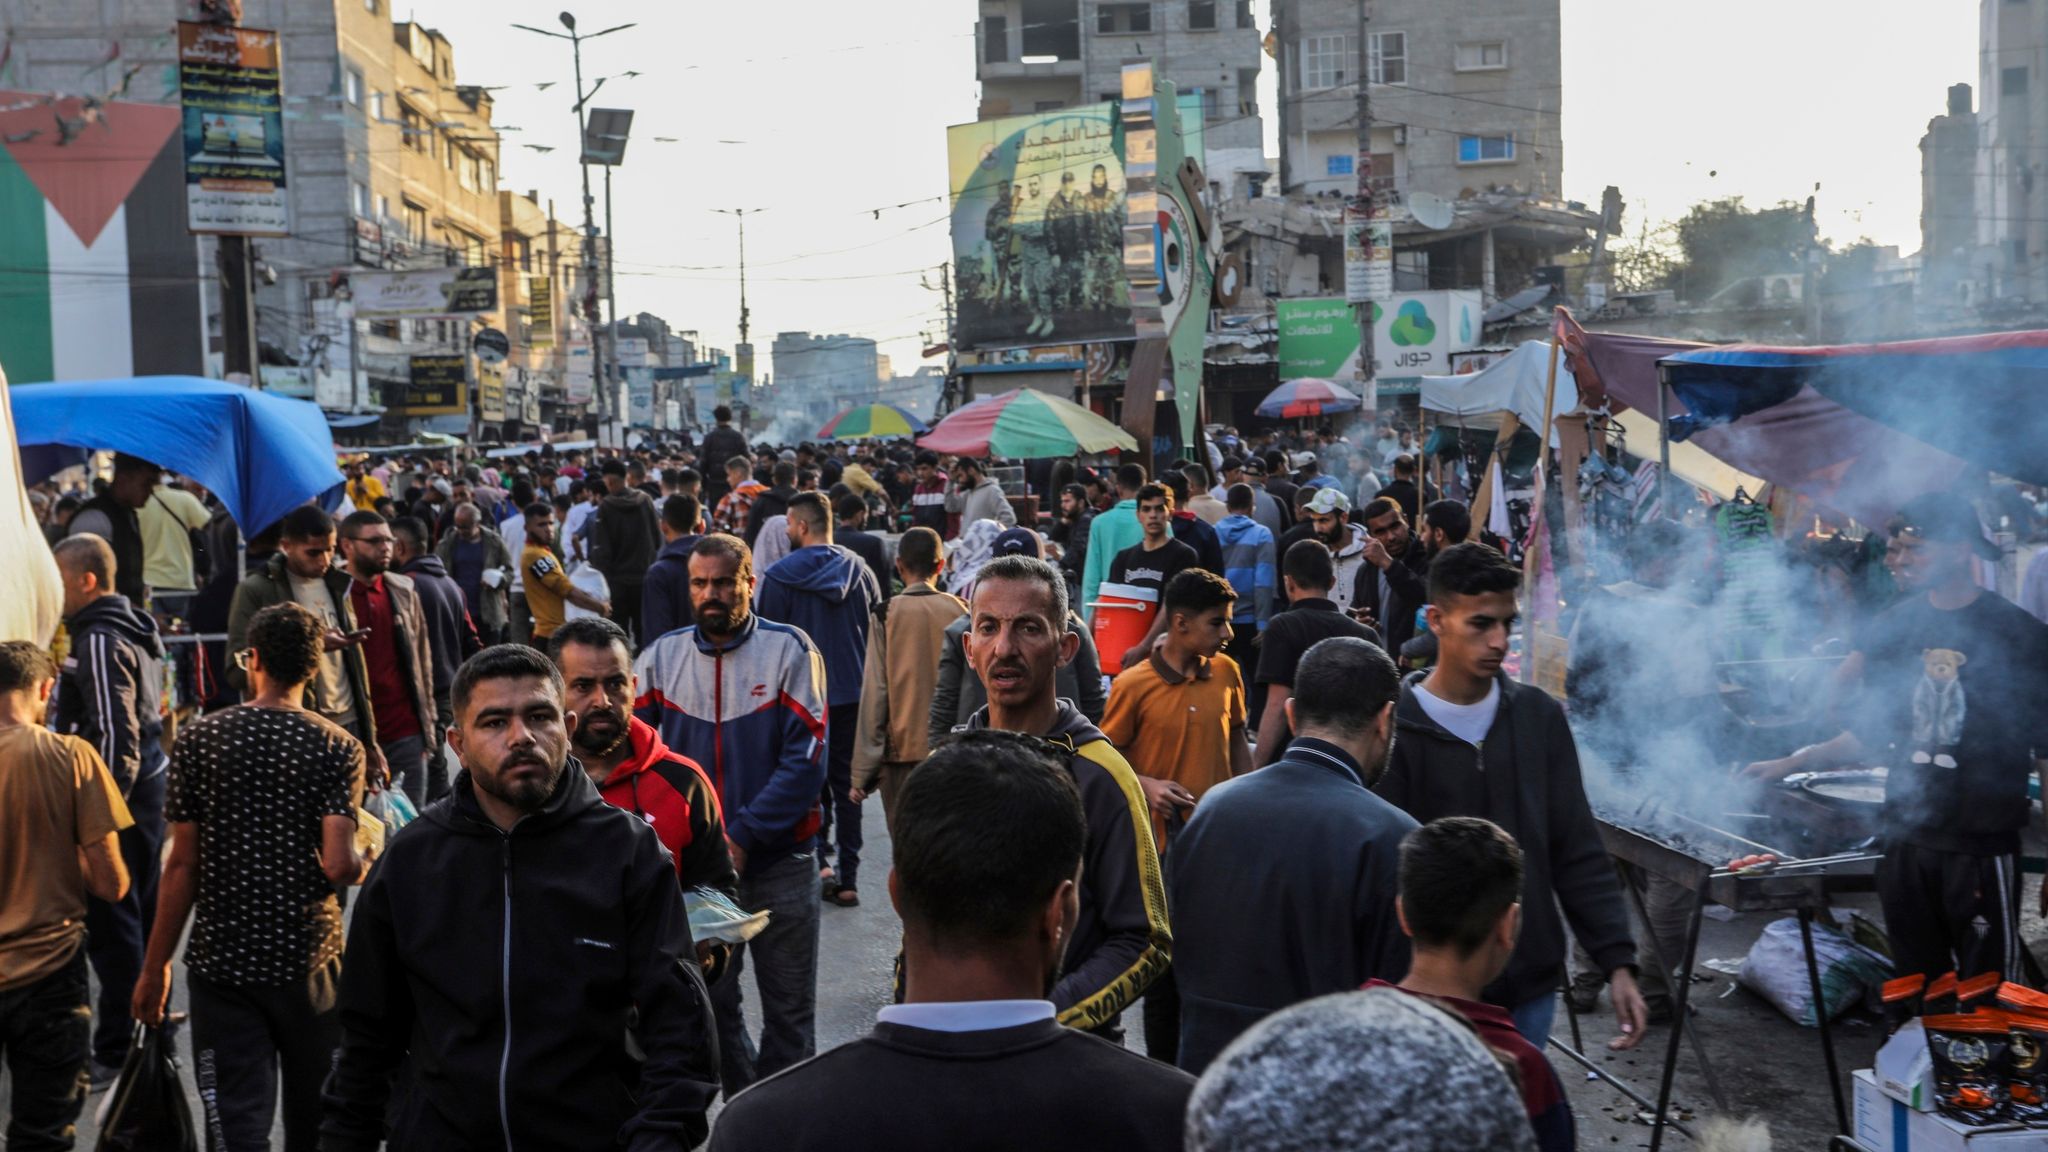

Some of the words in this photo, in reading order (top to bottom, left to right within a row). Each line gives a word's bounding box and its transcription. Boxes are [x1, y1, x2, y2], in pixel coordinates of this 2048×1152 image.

[1285, 308, 1312, 321] سنتر
[1285, 323, 1334, 336] للاتصالات
[1394, 351, 1433, 368] جوال
